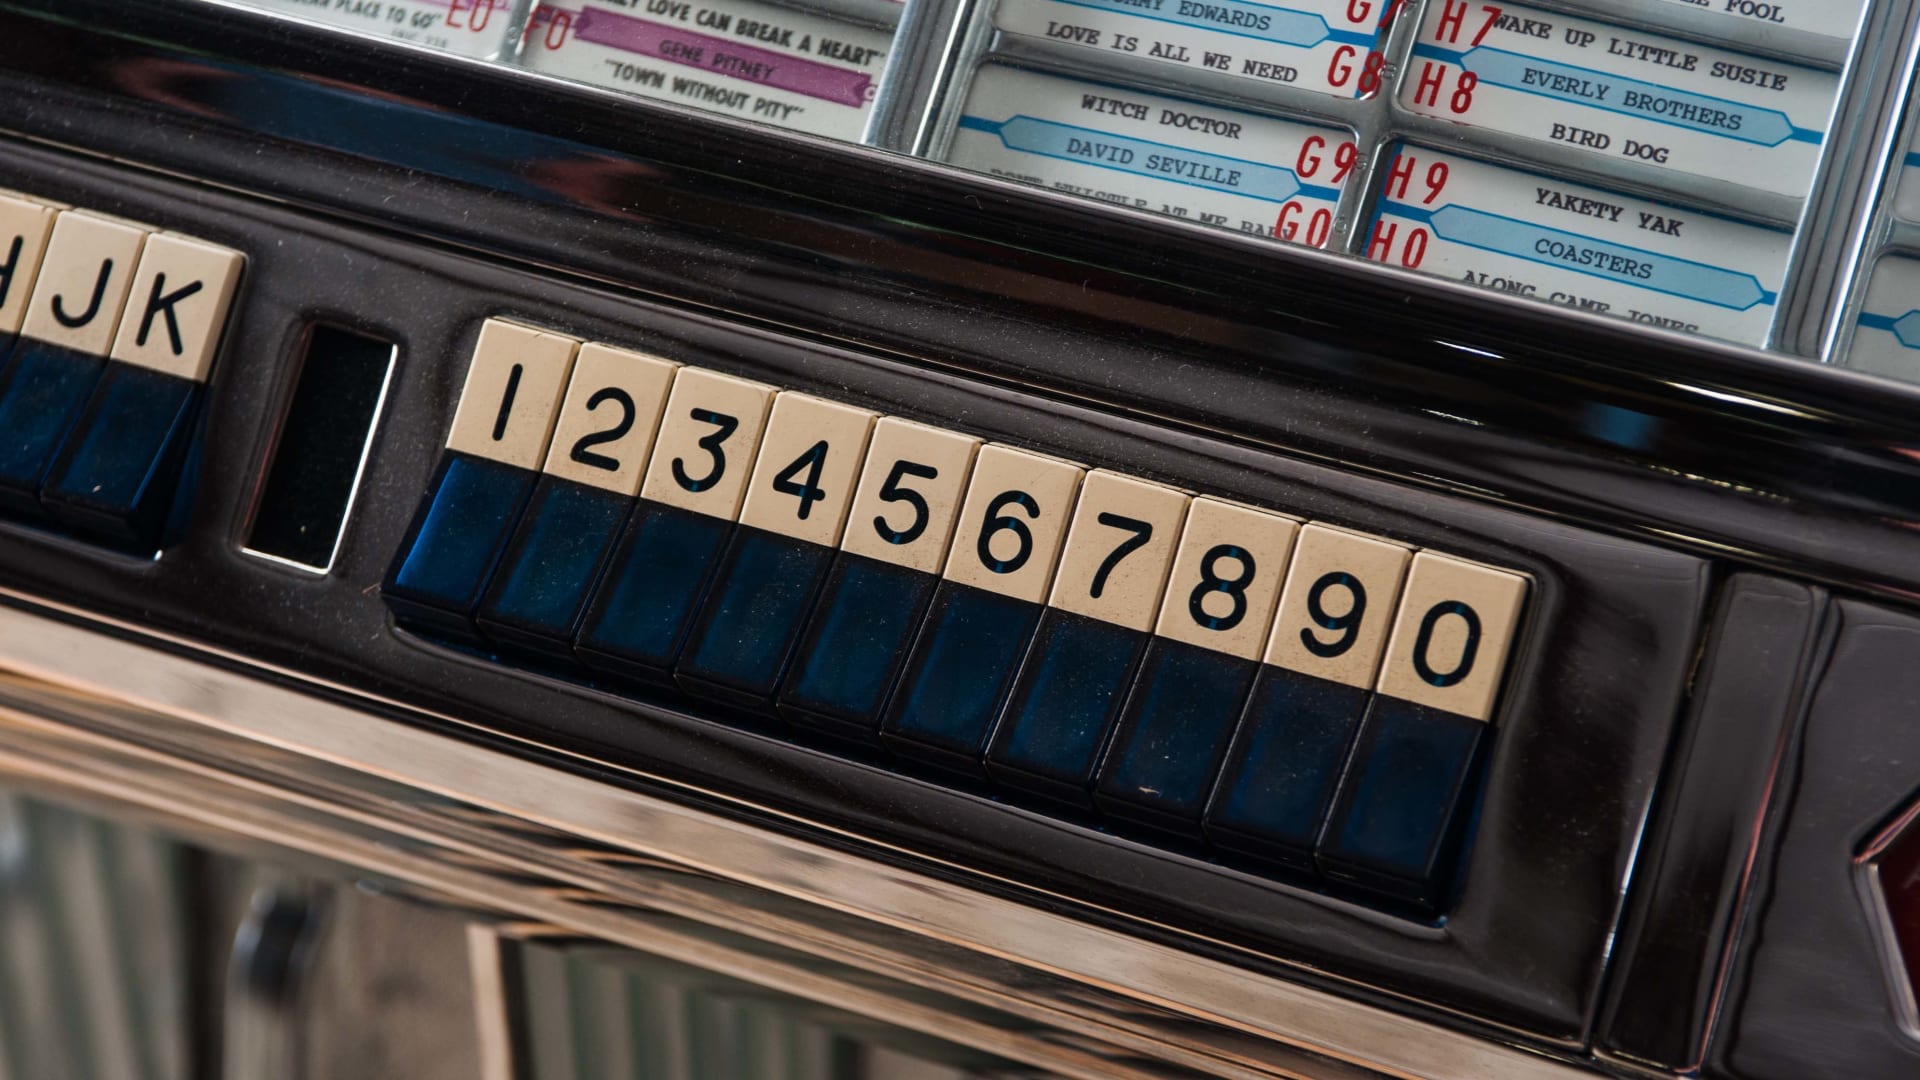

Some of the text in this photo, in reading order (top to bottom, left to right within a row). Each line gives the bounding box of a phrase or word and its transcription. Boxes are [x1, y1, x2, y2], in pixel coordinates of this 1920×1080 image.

[387, 6, 406, 23] TO
[646, 0, 689, 21] LOVE
[695, 8, 729, 32] CAN
[735, 18, 794, 47] BREAK
[797, 34, 811, 52] A
[1177, 0, 1271, 31] EDWARDS
[1435, 0, 1502, 47] H7
[1725, 0, 1784, 23] FOOL
[658, 39, 775, 81] GENE PITNEY
[1047, 21, 1297, 83] LOVE IS ALL WE NEED
[1327, 45, 1385, 95] G8
[1491, 12, 1788, 93] WAKE UP LITTLE SUSIE
[672, 74, 751, 110] WITHOUT
[1413, 61, 1478, 114] H8
[1521, 67, 1742, 131] EVERLY BROTHERS
[1081, 94, 1242, 140] WITCH DOCTOR
[1066, 137, 1242, 187] DAVID SEVILLE
[1296, 135, 1358, 184] G9
[1549, 123, 1670, 164] BIRD DOG
[1384, 153, 1449, 204] H9
[1535, 187, 1684, 237] YAKETY YAK
[1463, 270, 1536, 297] ALONG
[1534, 238, 1654, 280] COASTERS
[51, 258, 114, 329] J
[135, 271, 204, 356] K
[570, 386, 637, 473] 2
[671, 407, 739, 493] 3
[771, 440, 826, 521] 4
[873, 459, 938, 545] 5
[976, 490, 1041, 574] 6
[1097, 512, 1154, 599] 7
[1188, 544, 1257, 631] 8
[1299, 570, 1367, 658] 9
